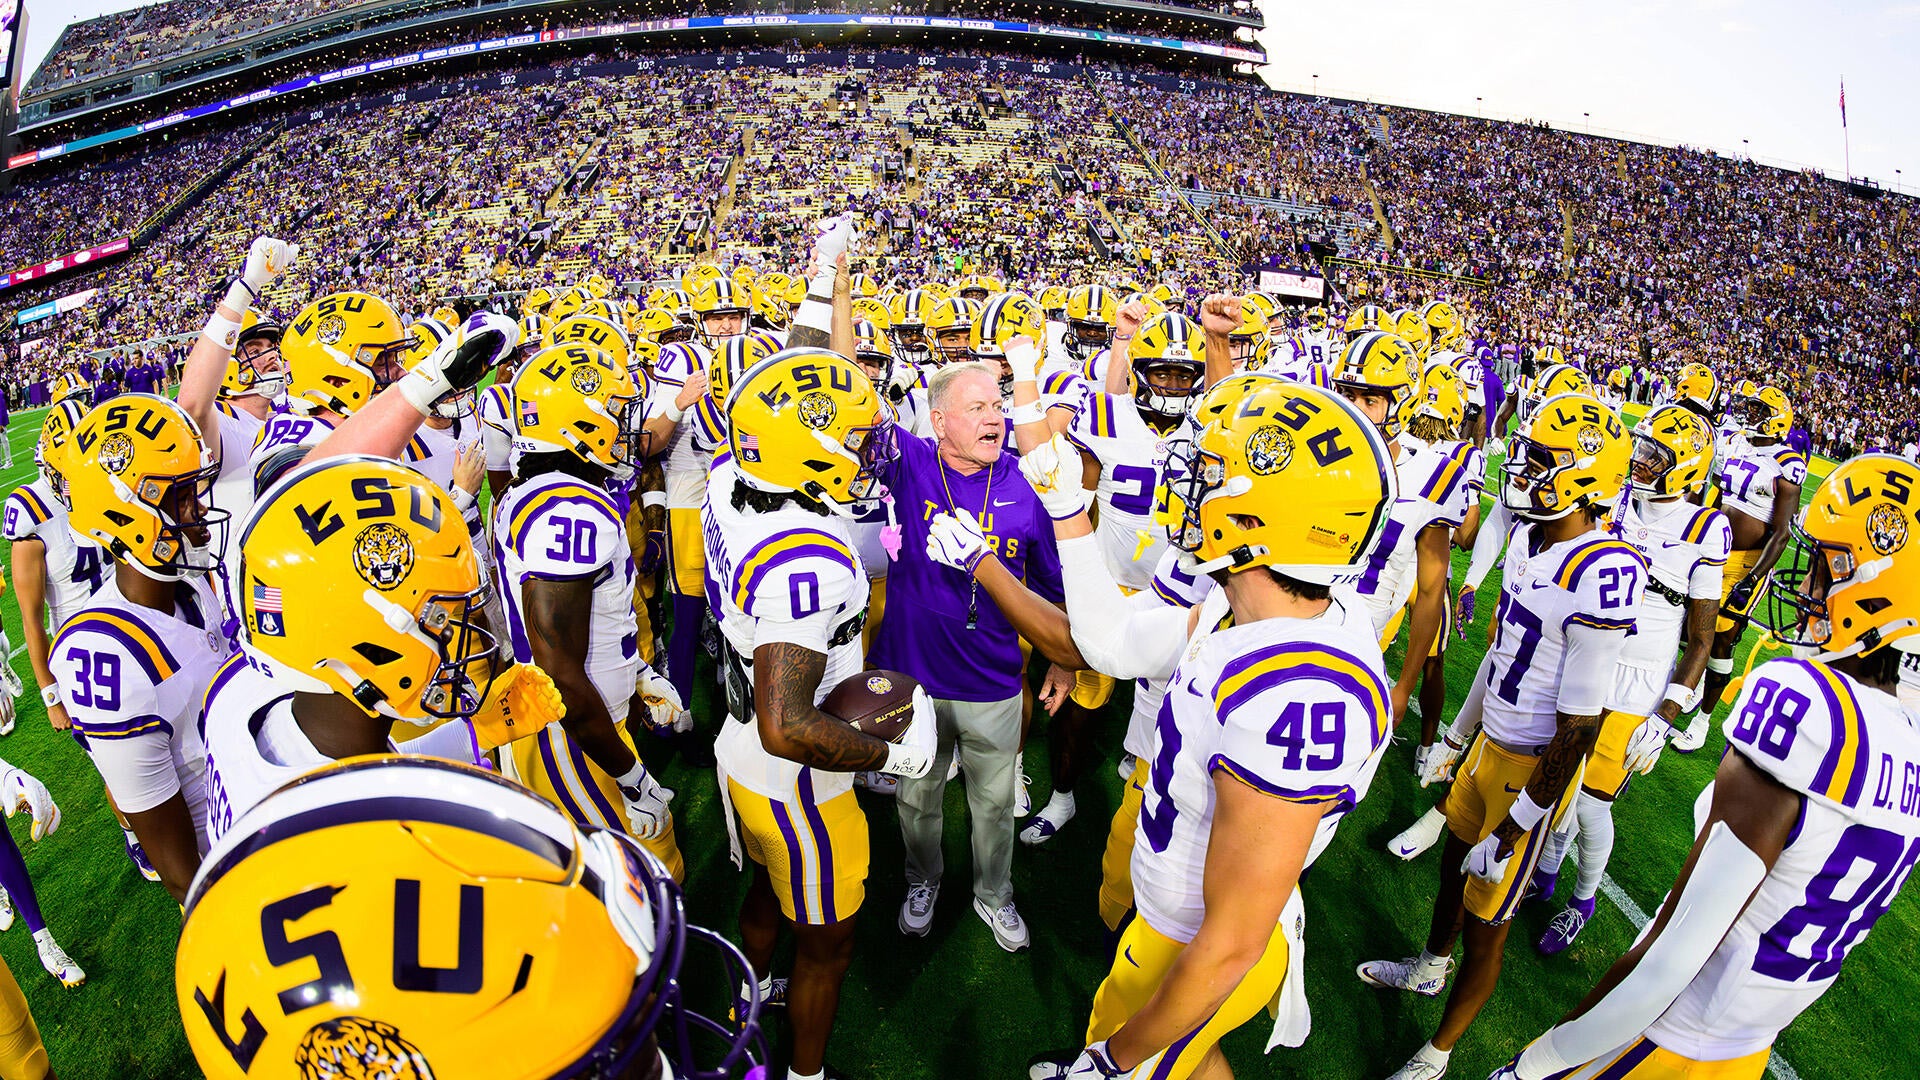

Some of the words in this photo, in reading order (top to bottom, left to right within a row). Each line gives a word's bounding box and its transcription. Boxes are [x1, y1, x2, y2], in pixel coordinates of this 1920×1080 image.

[786, 54, 806, 63] 104
[917, 56, 937, 66] 105
[1032, 63, 1051, 74] 106
[392, 92, 407, 103] 101
[500, 75, 516, 85] 102
[1178, 80, 1196, 90] 23
[310, 110, 324, 121] 100
[1263, 276, 1320, 293] MANDA
[294, 297, 366, 337] LSU
[539, 347, 615, 382] LSU
[1170, 349, 1187, 357] LSU
[1312, 345, 1324, 363] 8
[758, 364, 853, 412] LSU
[1342, 372, 1358, 382] LSU
[76, 405, 167, 455] LSU
[263, 419, 314, 452] 89
[1239, 393, 1353, 467] LSU
[1555, 404, 1621, 440] LSU
[1721, 458, 1760, 503] 57
[1792, 467, 1806, 486] 57
[293, 478, 441, 546] LSU
[1844, 469, 1920, 521] LS
[546, 515, 598, 564] 30
[703, 513, 732, 593] THOMAS
[788, 571, 820, 620] 0
[1510, 582, 1522, 596] LSU
[1598, 565, 1637, 610] 27
[67, 646, 121, 712] 39
[1265, 701, 1346, 771] 49
[1732, 676, 1811, 761] 88
[1873, 752, 1893, 810] D.
[194, 878, 484, 1073] LSU
[1416, 977, 1439, 993] NIKE
